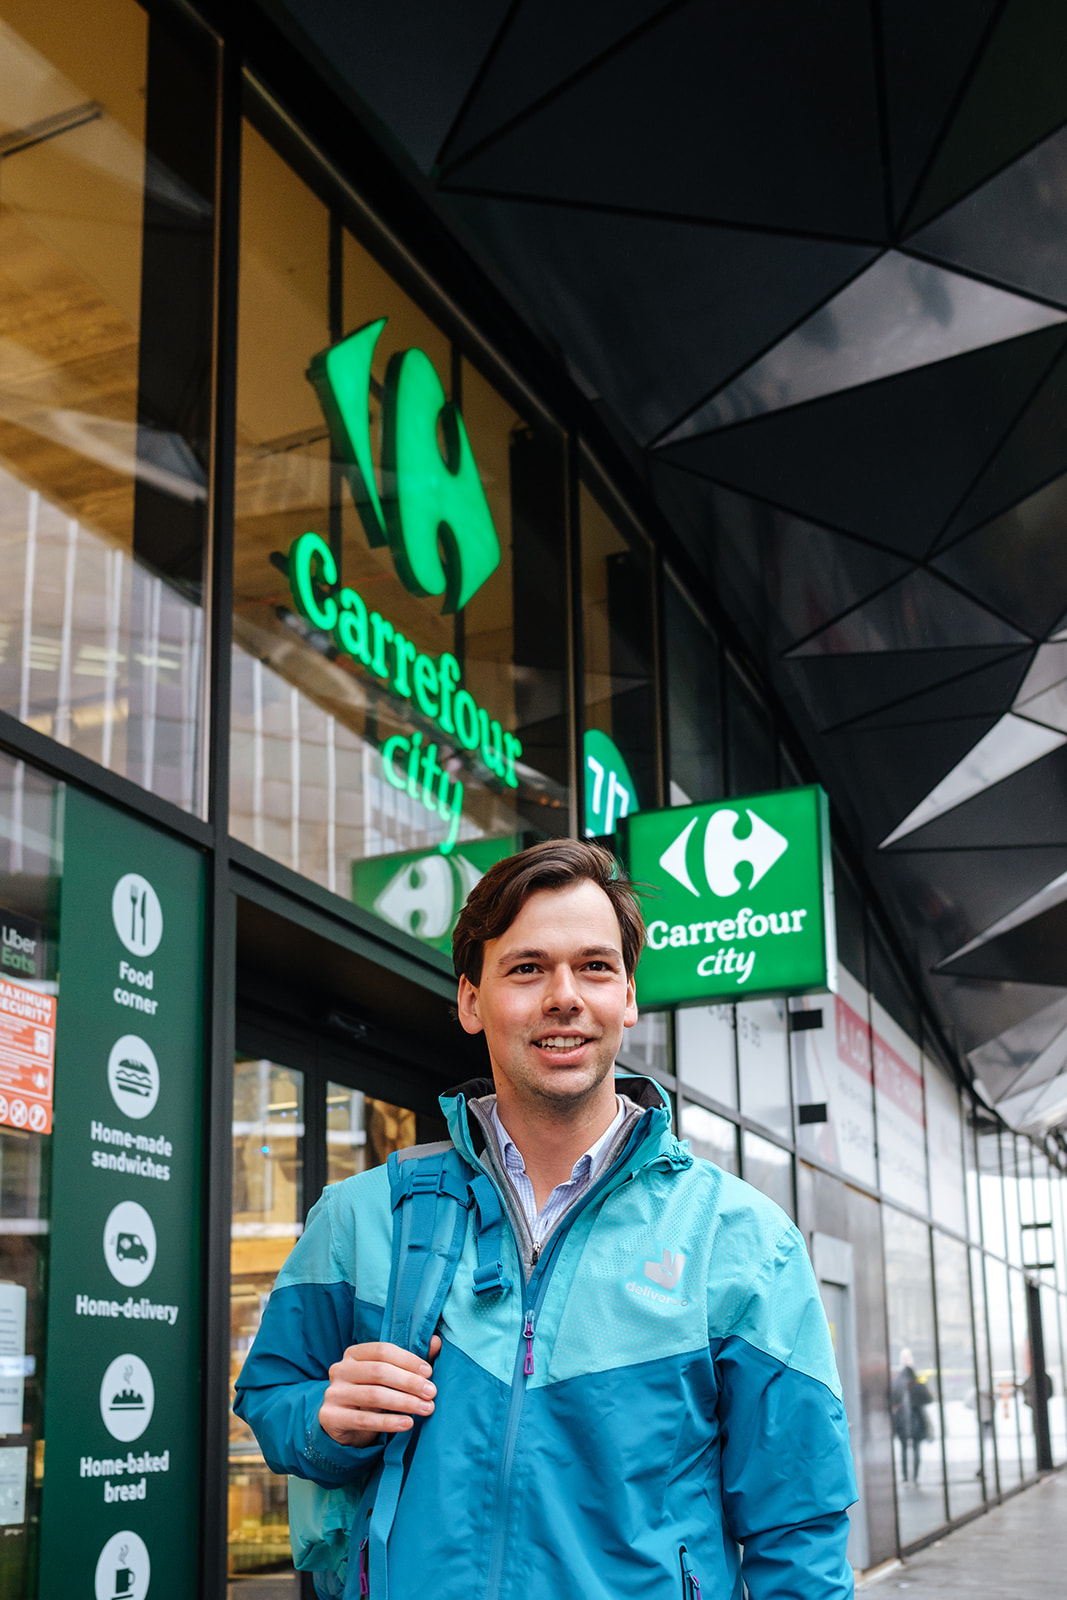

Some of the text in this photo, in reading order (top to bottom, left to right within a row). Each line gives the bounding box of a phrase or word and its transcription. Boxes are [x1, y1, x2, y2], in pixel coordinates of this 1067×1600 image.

[292, 532, 522, 788] Carrefour
[383, 732, 464, 855] city
[2, 925, 37, 954] Uber
[646, 908, 807, 949] Carrefour
[2, 947, 36, 975] Eats
[119, 961, 154, 990] Food
[697, 948, 756, 984] city
[0, 998, 52, 1025] ECURITY
[113, 988, 159, 1015] corner
[91, 1120, 173, 1157] Home-made
[91, 1150, 171, 1181] sandwiches
[76, 1294, 179, 1325] Home-delivery
[79, 1450, 170, 1478] Home-baked
[104, 1477, 147, 1504] bread
